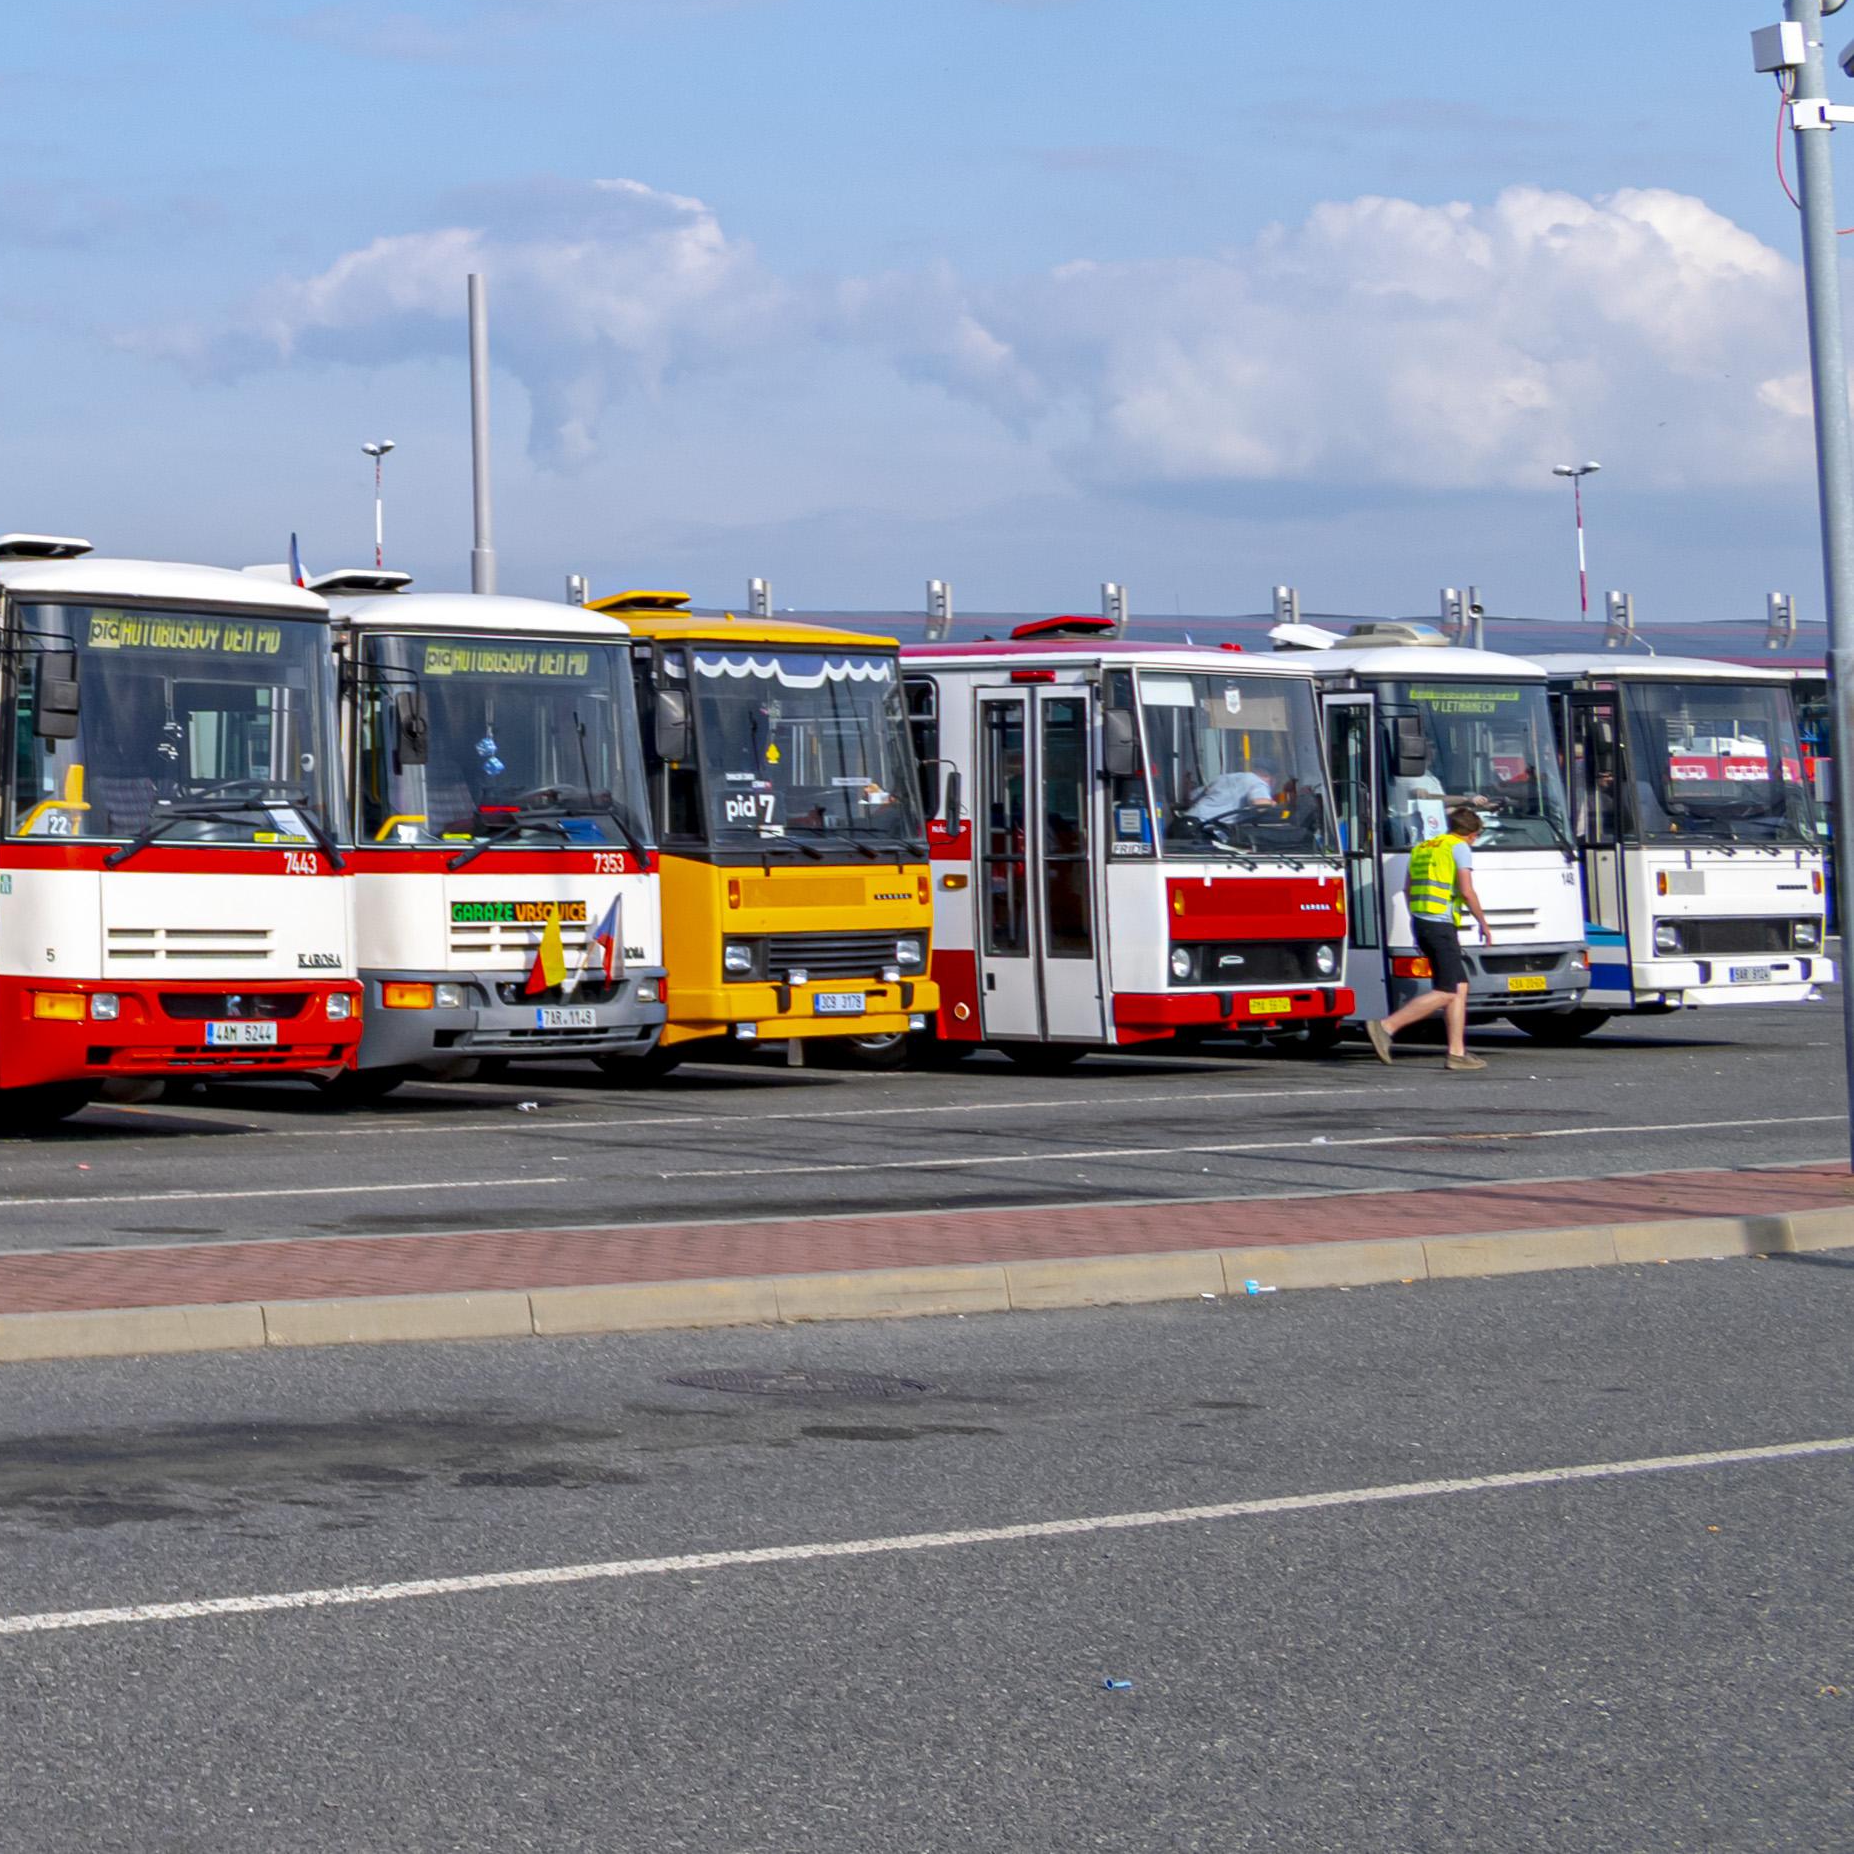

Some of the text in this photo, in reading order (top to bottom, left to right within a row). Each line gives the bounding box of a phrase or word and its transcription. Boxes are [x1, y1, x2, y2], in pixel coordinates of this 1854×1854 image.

[725, 794, 775, 823] pid 7
[49, 815, 68, 834] 22
[283, 852, 318, 874] 7443
[593, 853, 625, 873] 7353
[452, 901, 514, 921] GARÁŽE
[46, 948, 55, 962] 5
[298, 954, 342, 968] KAROSA
[245, 1024, 271, 1041] 5244
